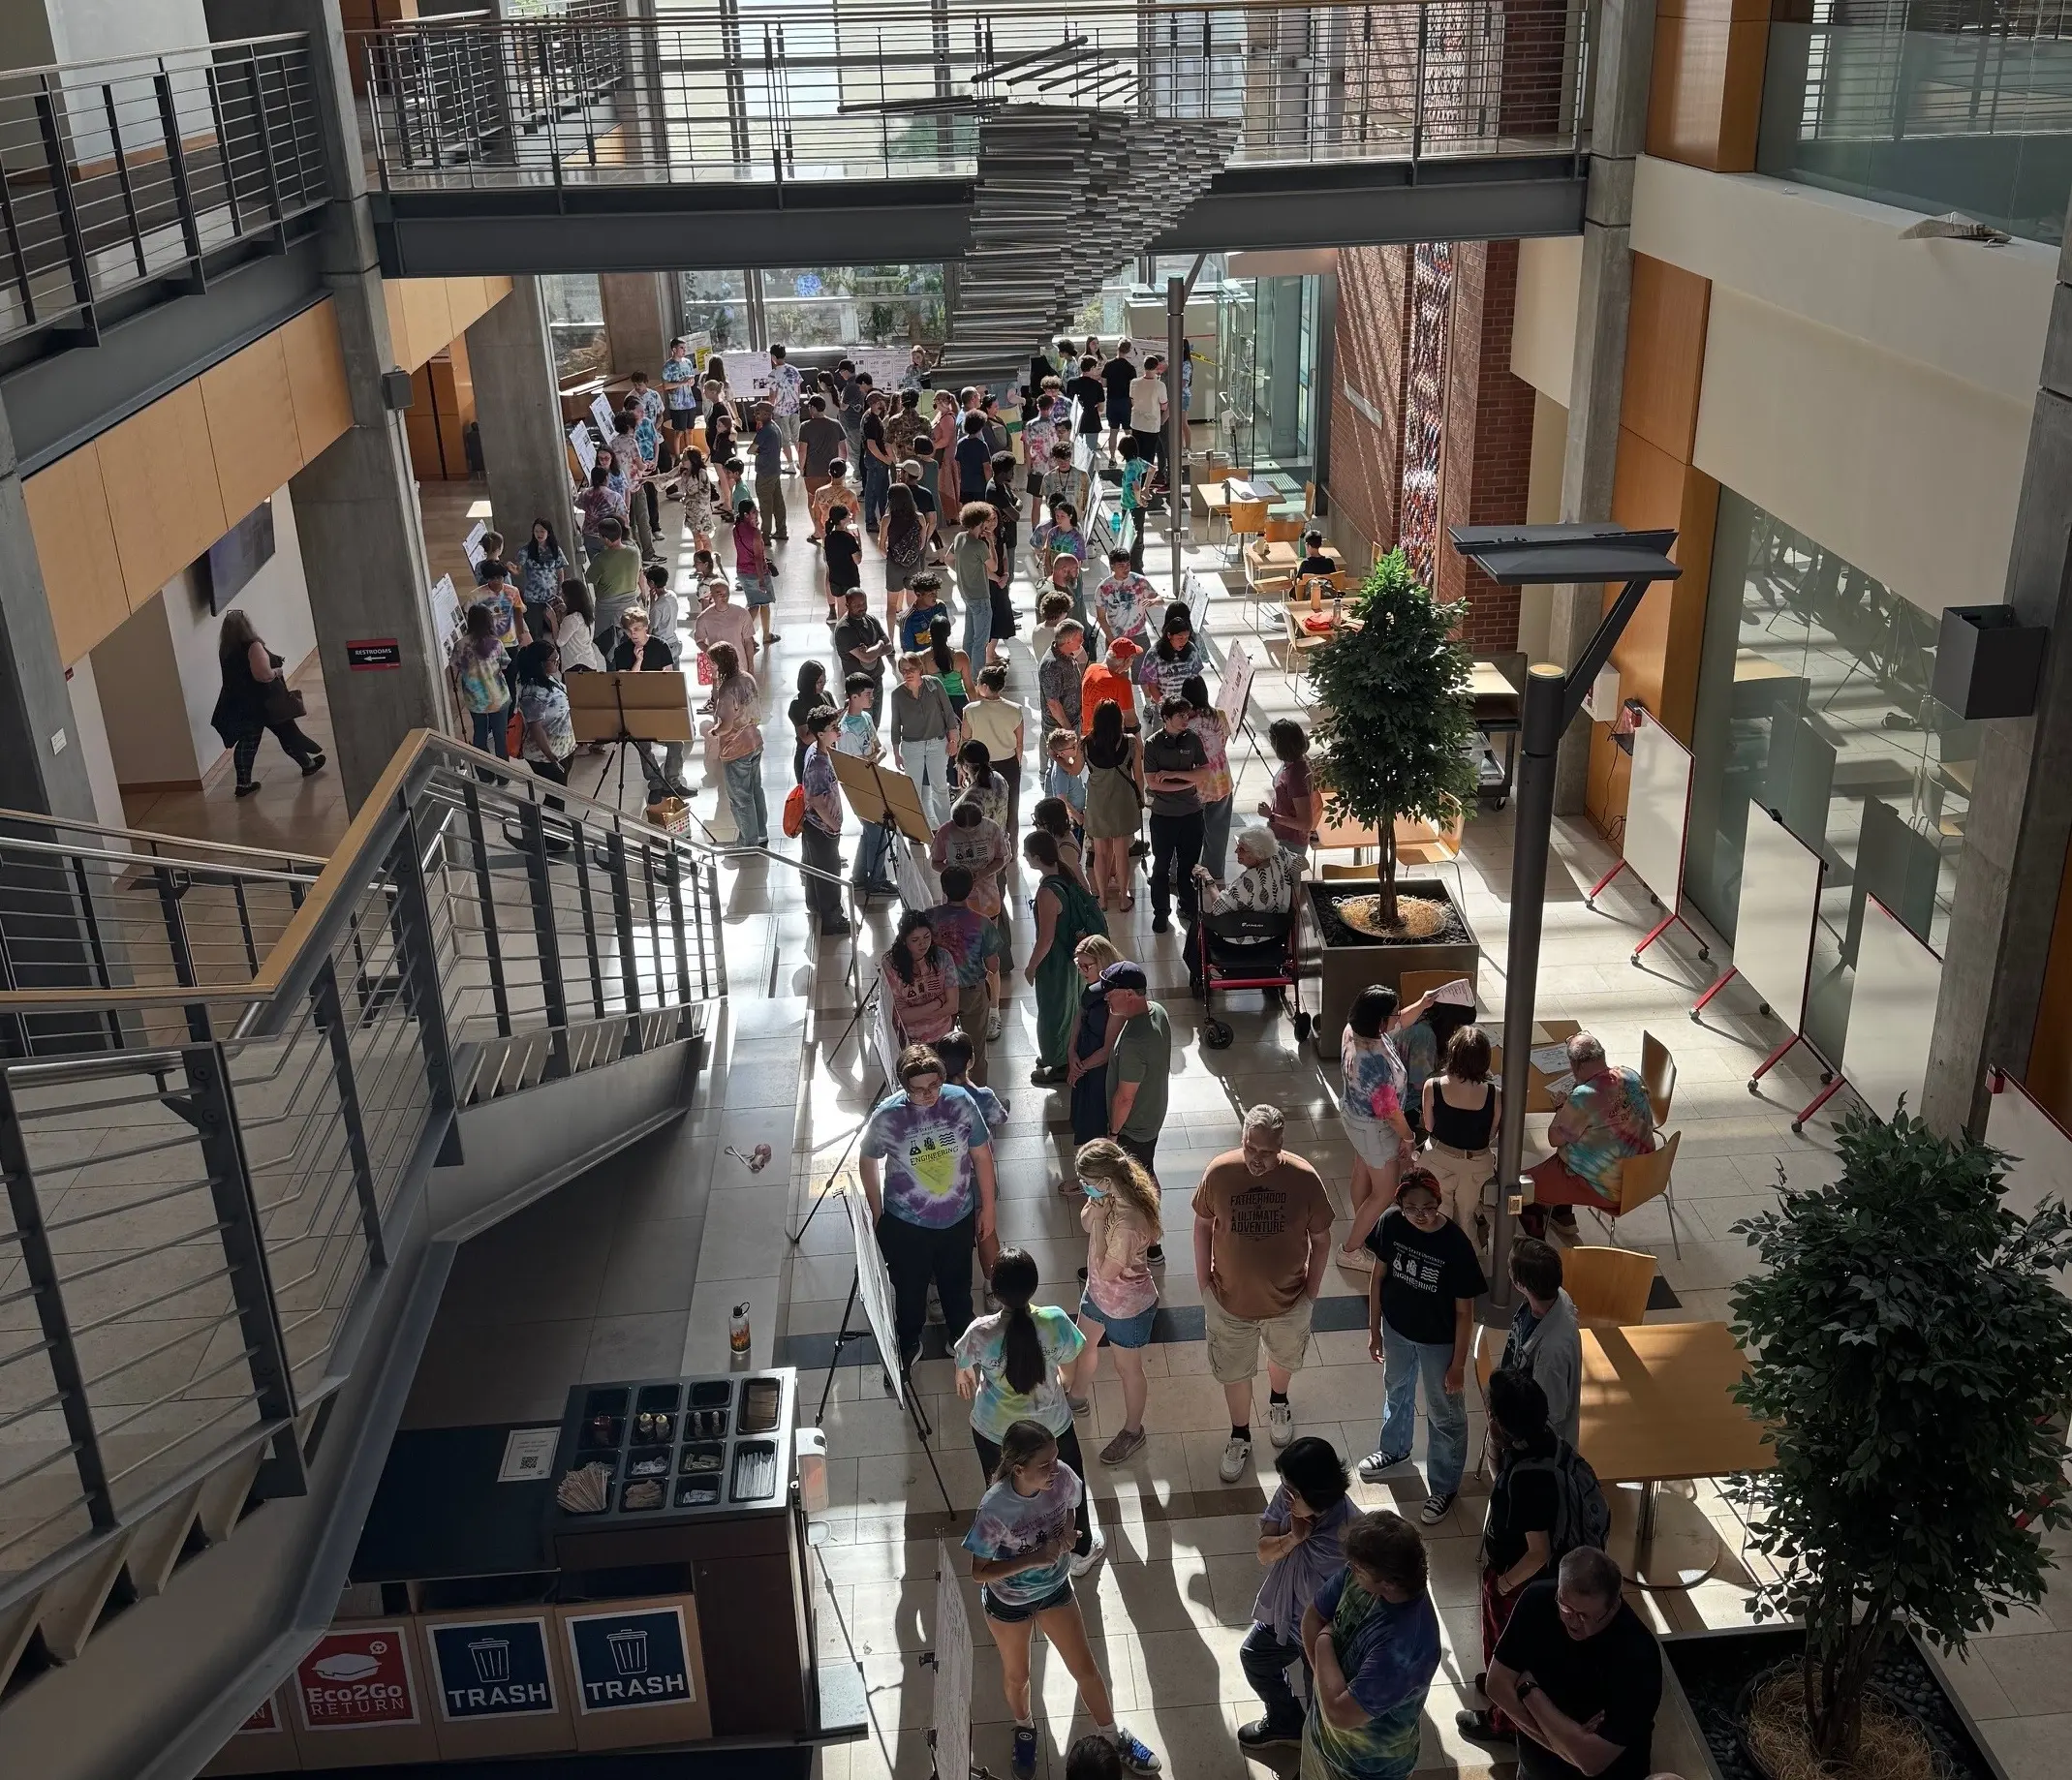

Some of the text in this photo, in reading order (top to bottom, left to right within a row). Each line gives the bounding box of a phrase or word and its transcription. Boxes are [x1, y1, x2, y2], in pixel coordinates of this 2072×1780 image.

[911, 1146, 959, 1166] ENGINEERING
[1230, 1192, 1286, 1206] FATHERHOOD
[1238, 1211, 1280, 1221] ULTIMATE
[1231, 1221, 1284, 1233] ADVENTURE
[1392, 1268, 1438, 1293] ENGINEERING
[306, 1683, 403, 1703] Eco2Go
[448, 1682, 547, 1708] TRASH
[586, 1673, 685, 1701] TRASH
[310, 1697, 405, 1716] RETURN
